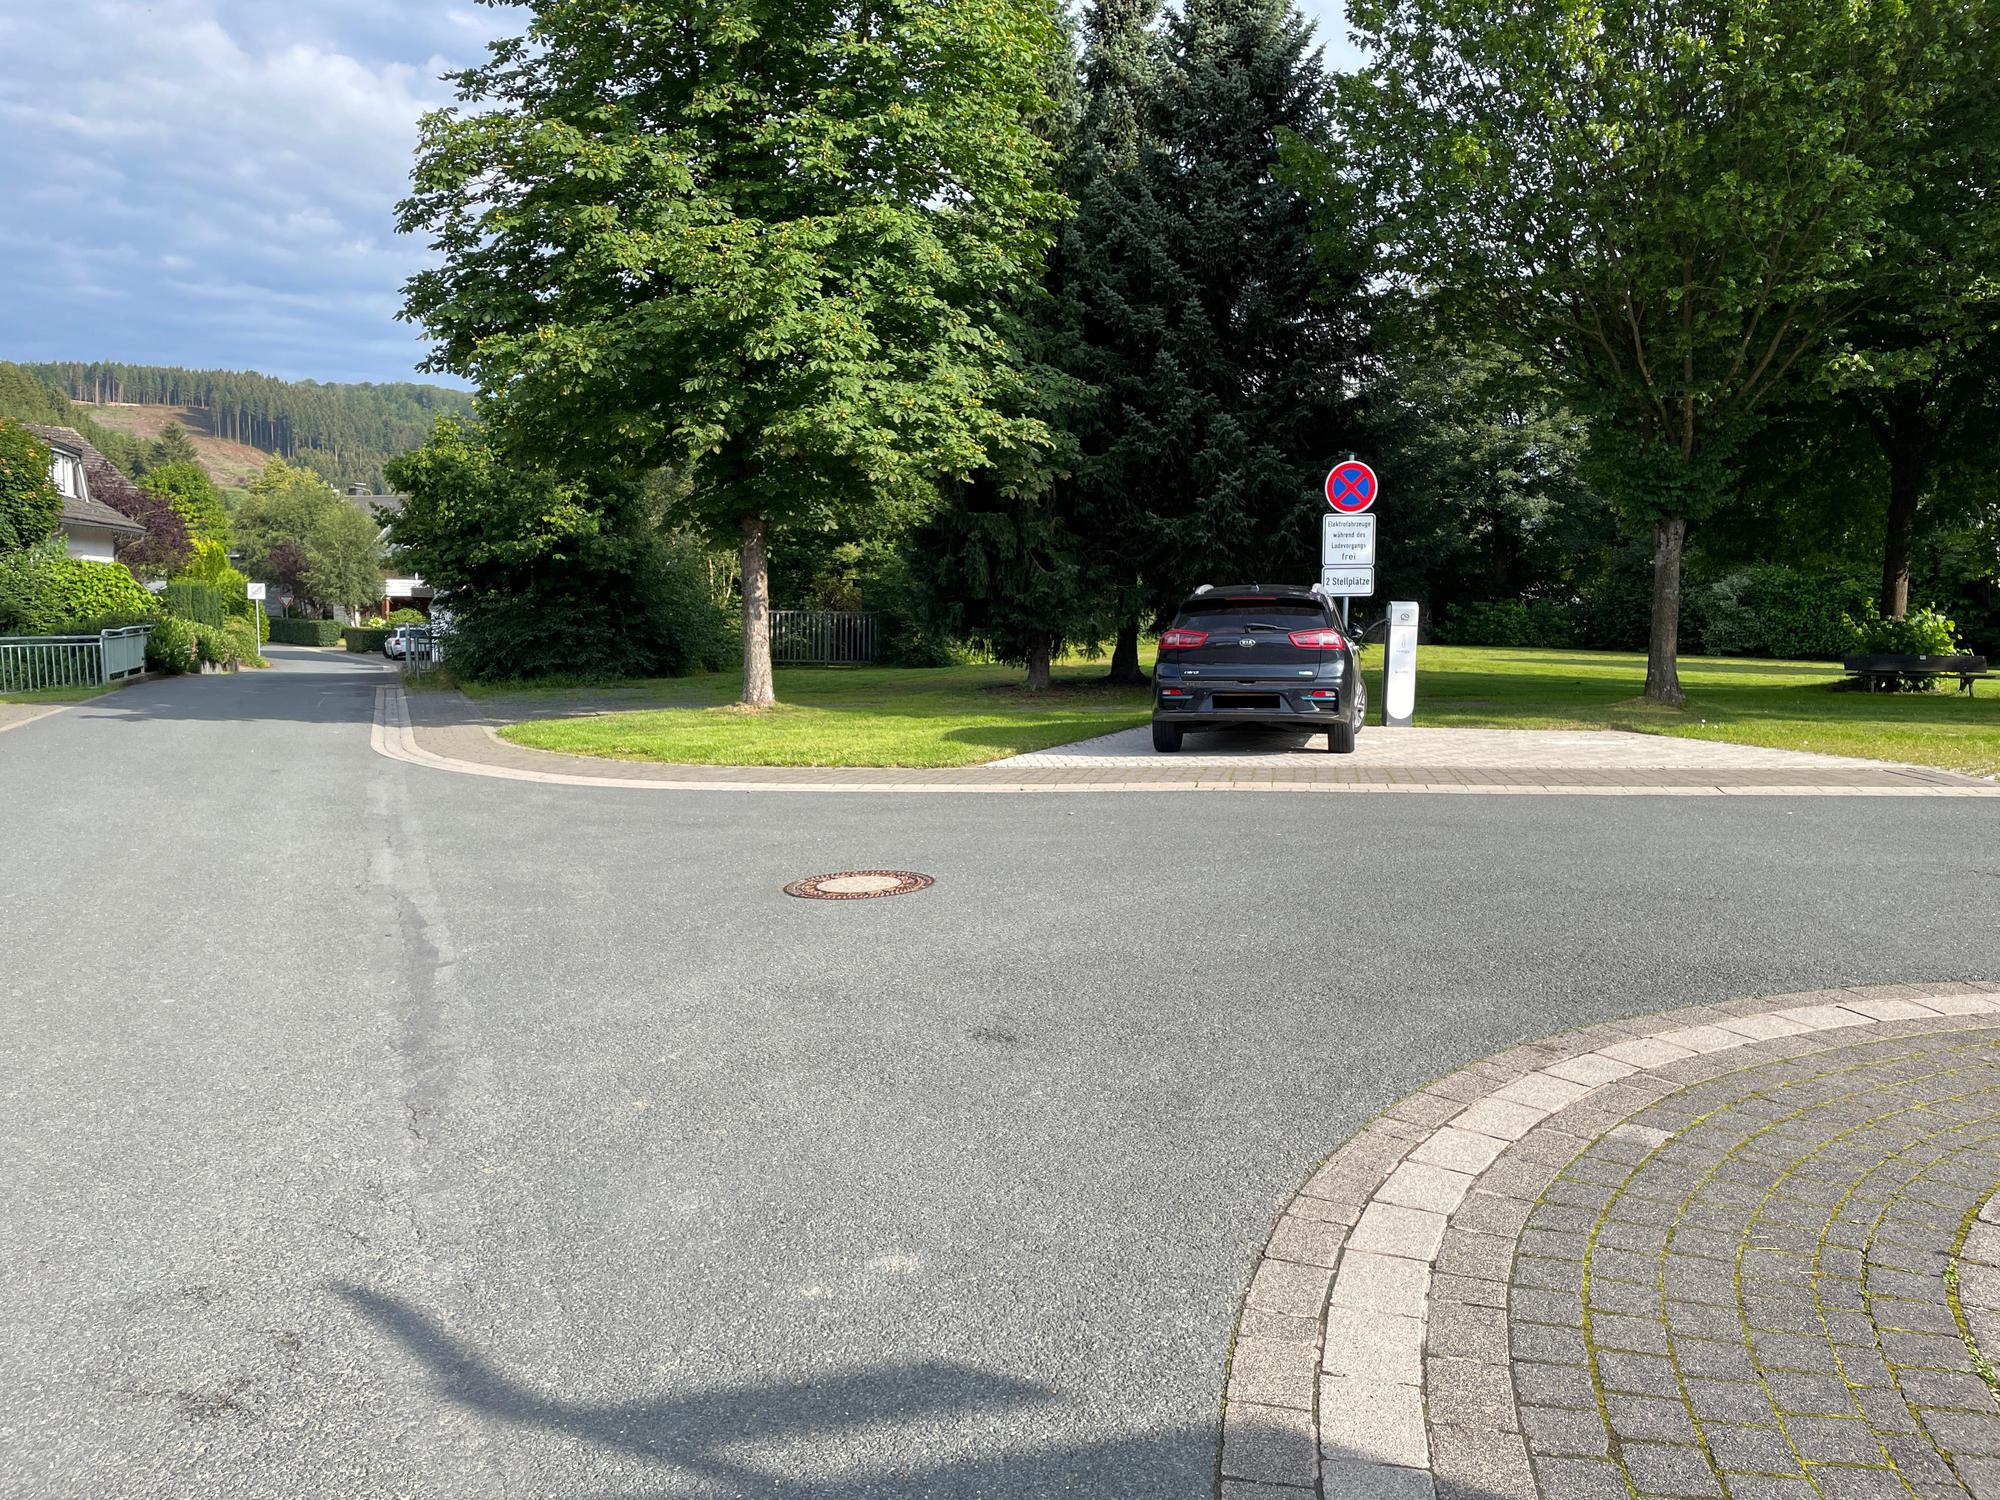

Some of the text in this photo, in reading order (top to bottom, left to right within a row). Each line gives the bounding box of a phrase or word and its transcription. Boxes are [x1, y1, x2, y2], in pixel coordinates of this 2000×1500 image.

[1331, 542, 1366, 550] Ladevorgangs
[1325, 577, 1370, 587] 2 Stellplätze
